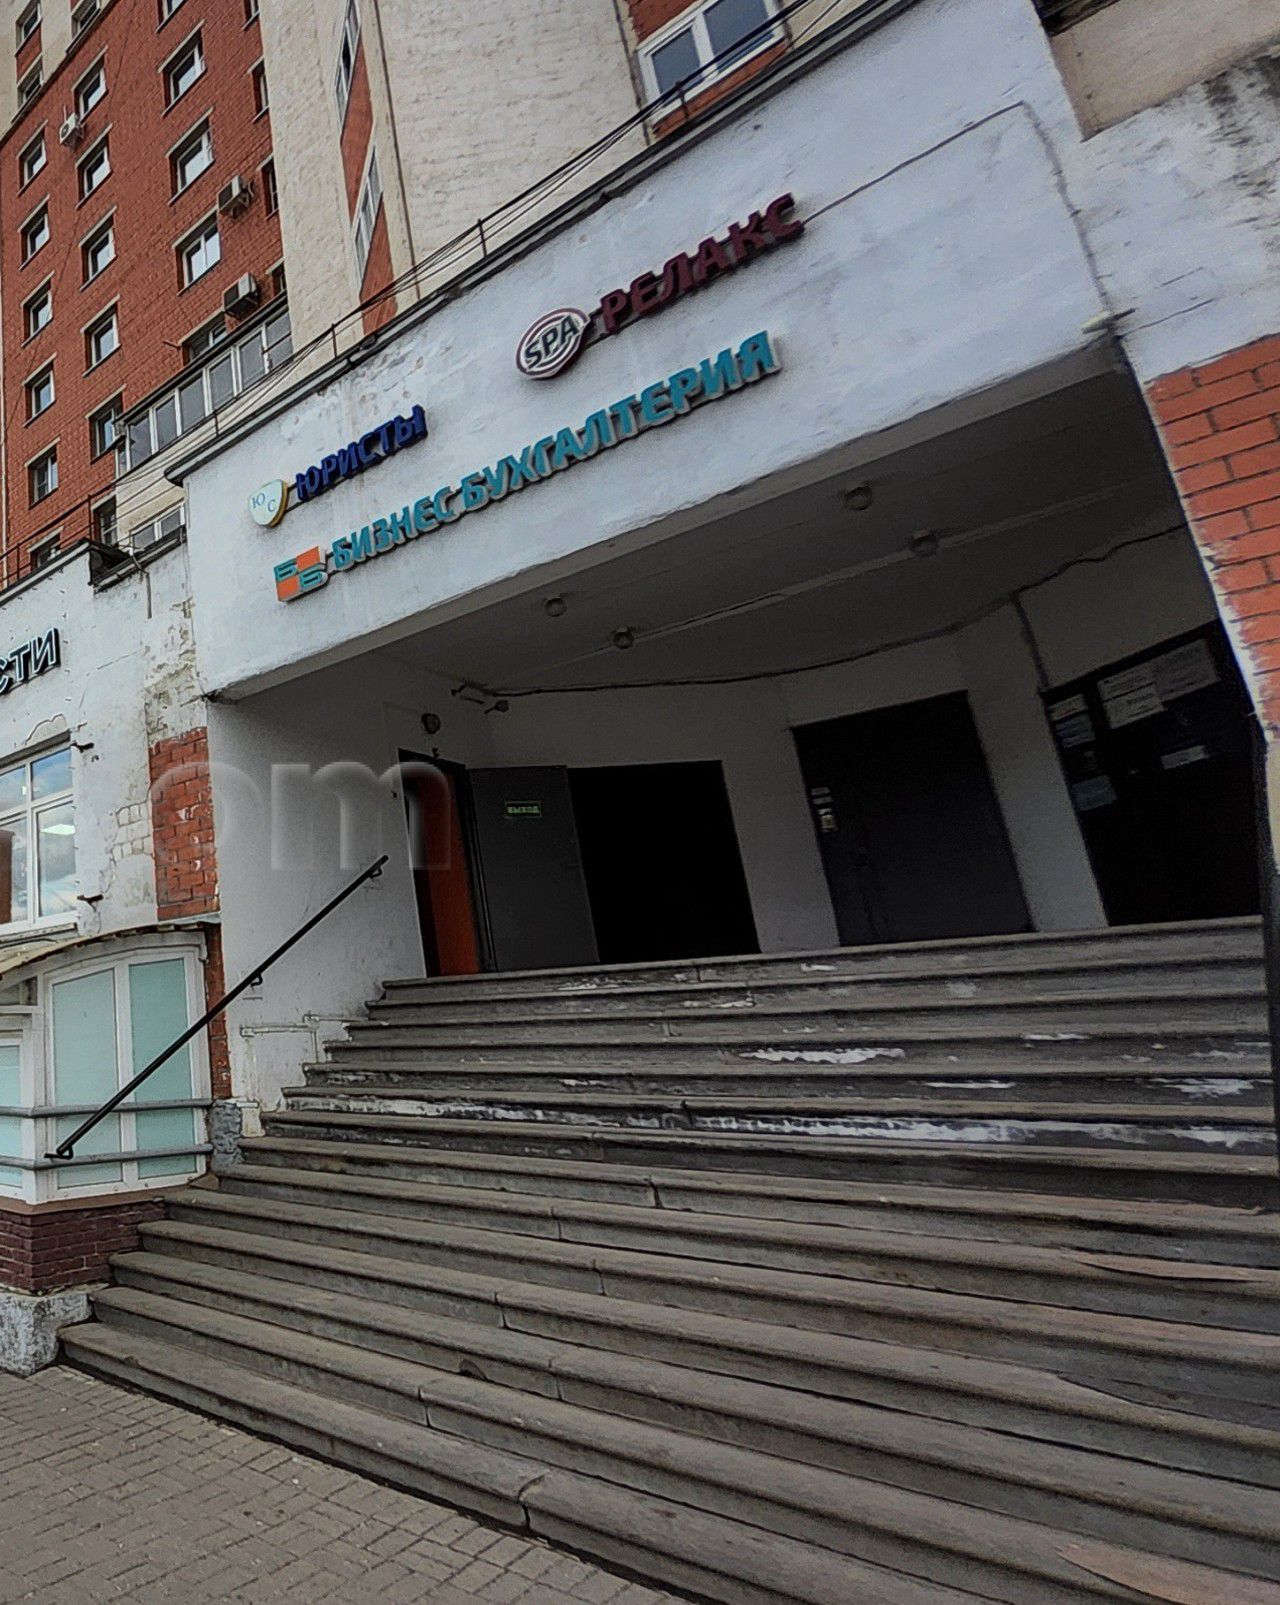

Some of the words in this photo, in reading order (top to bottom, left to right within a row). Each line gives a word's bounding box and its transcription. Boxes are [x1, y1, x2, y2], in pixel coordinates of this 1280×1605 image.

[524, 315, 581, 369] SPA
[599, 192, 805, 333] РЕЛАКС
[295, 404, 427, 501] ЮРИСТЫ
[331, 485, 457, 571] БИЗНЕС
[460, 329, 780, 509] БУХГАЛТЕРИЯ
